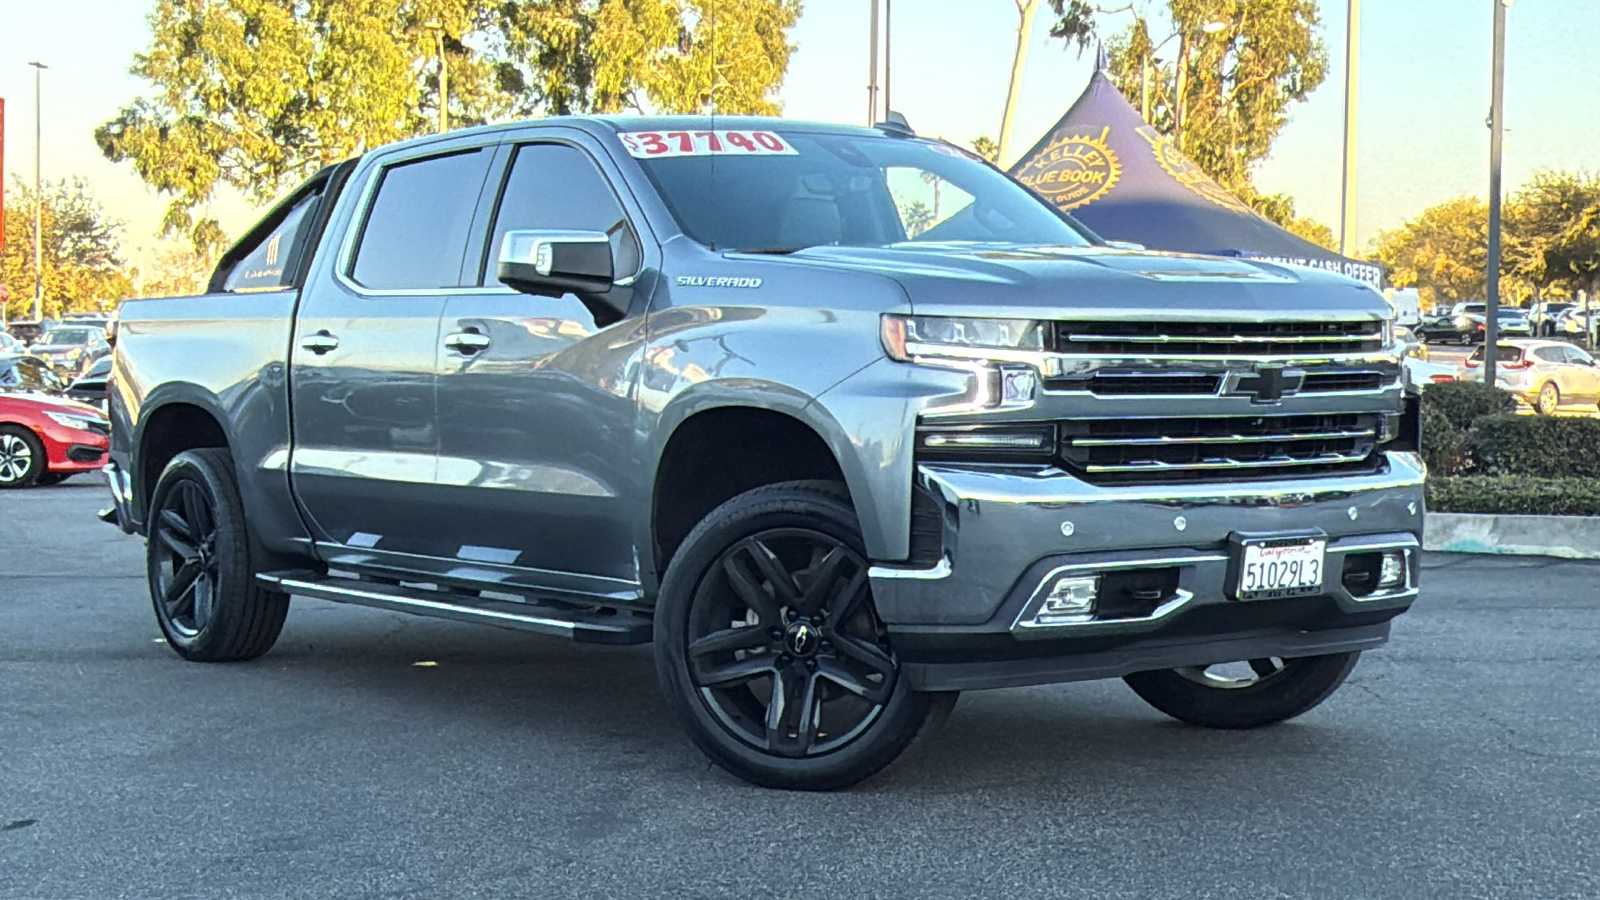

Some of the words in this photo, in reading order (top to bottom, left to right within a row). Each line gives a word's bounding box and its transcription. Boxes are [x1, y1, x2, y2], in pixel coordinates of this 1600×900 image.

[1034, 145, 1106, 169] KELLEY
[1057, 169, 1107, 184] BOOK
[677, 276, 762, 288] SILVERADO
[1344, 262, 1381, 289] OFFER
[1246, 559, 1319, 589] 51029L3
